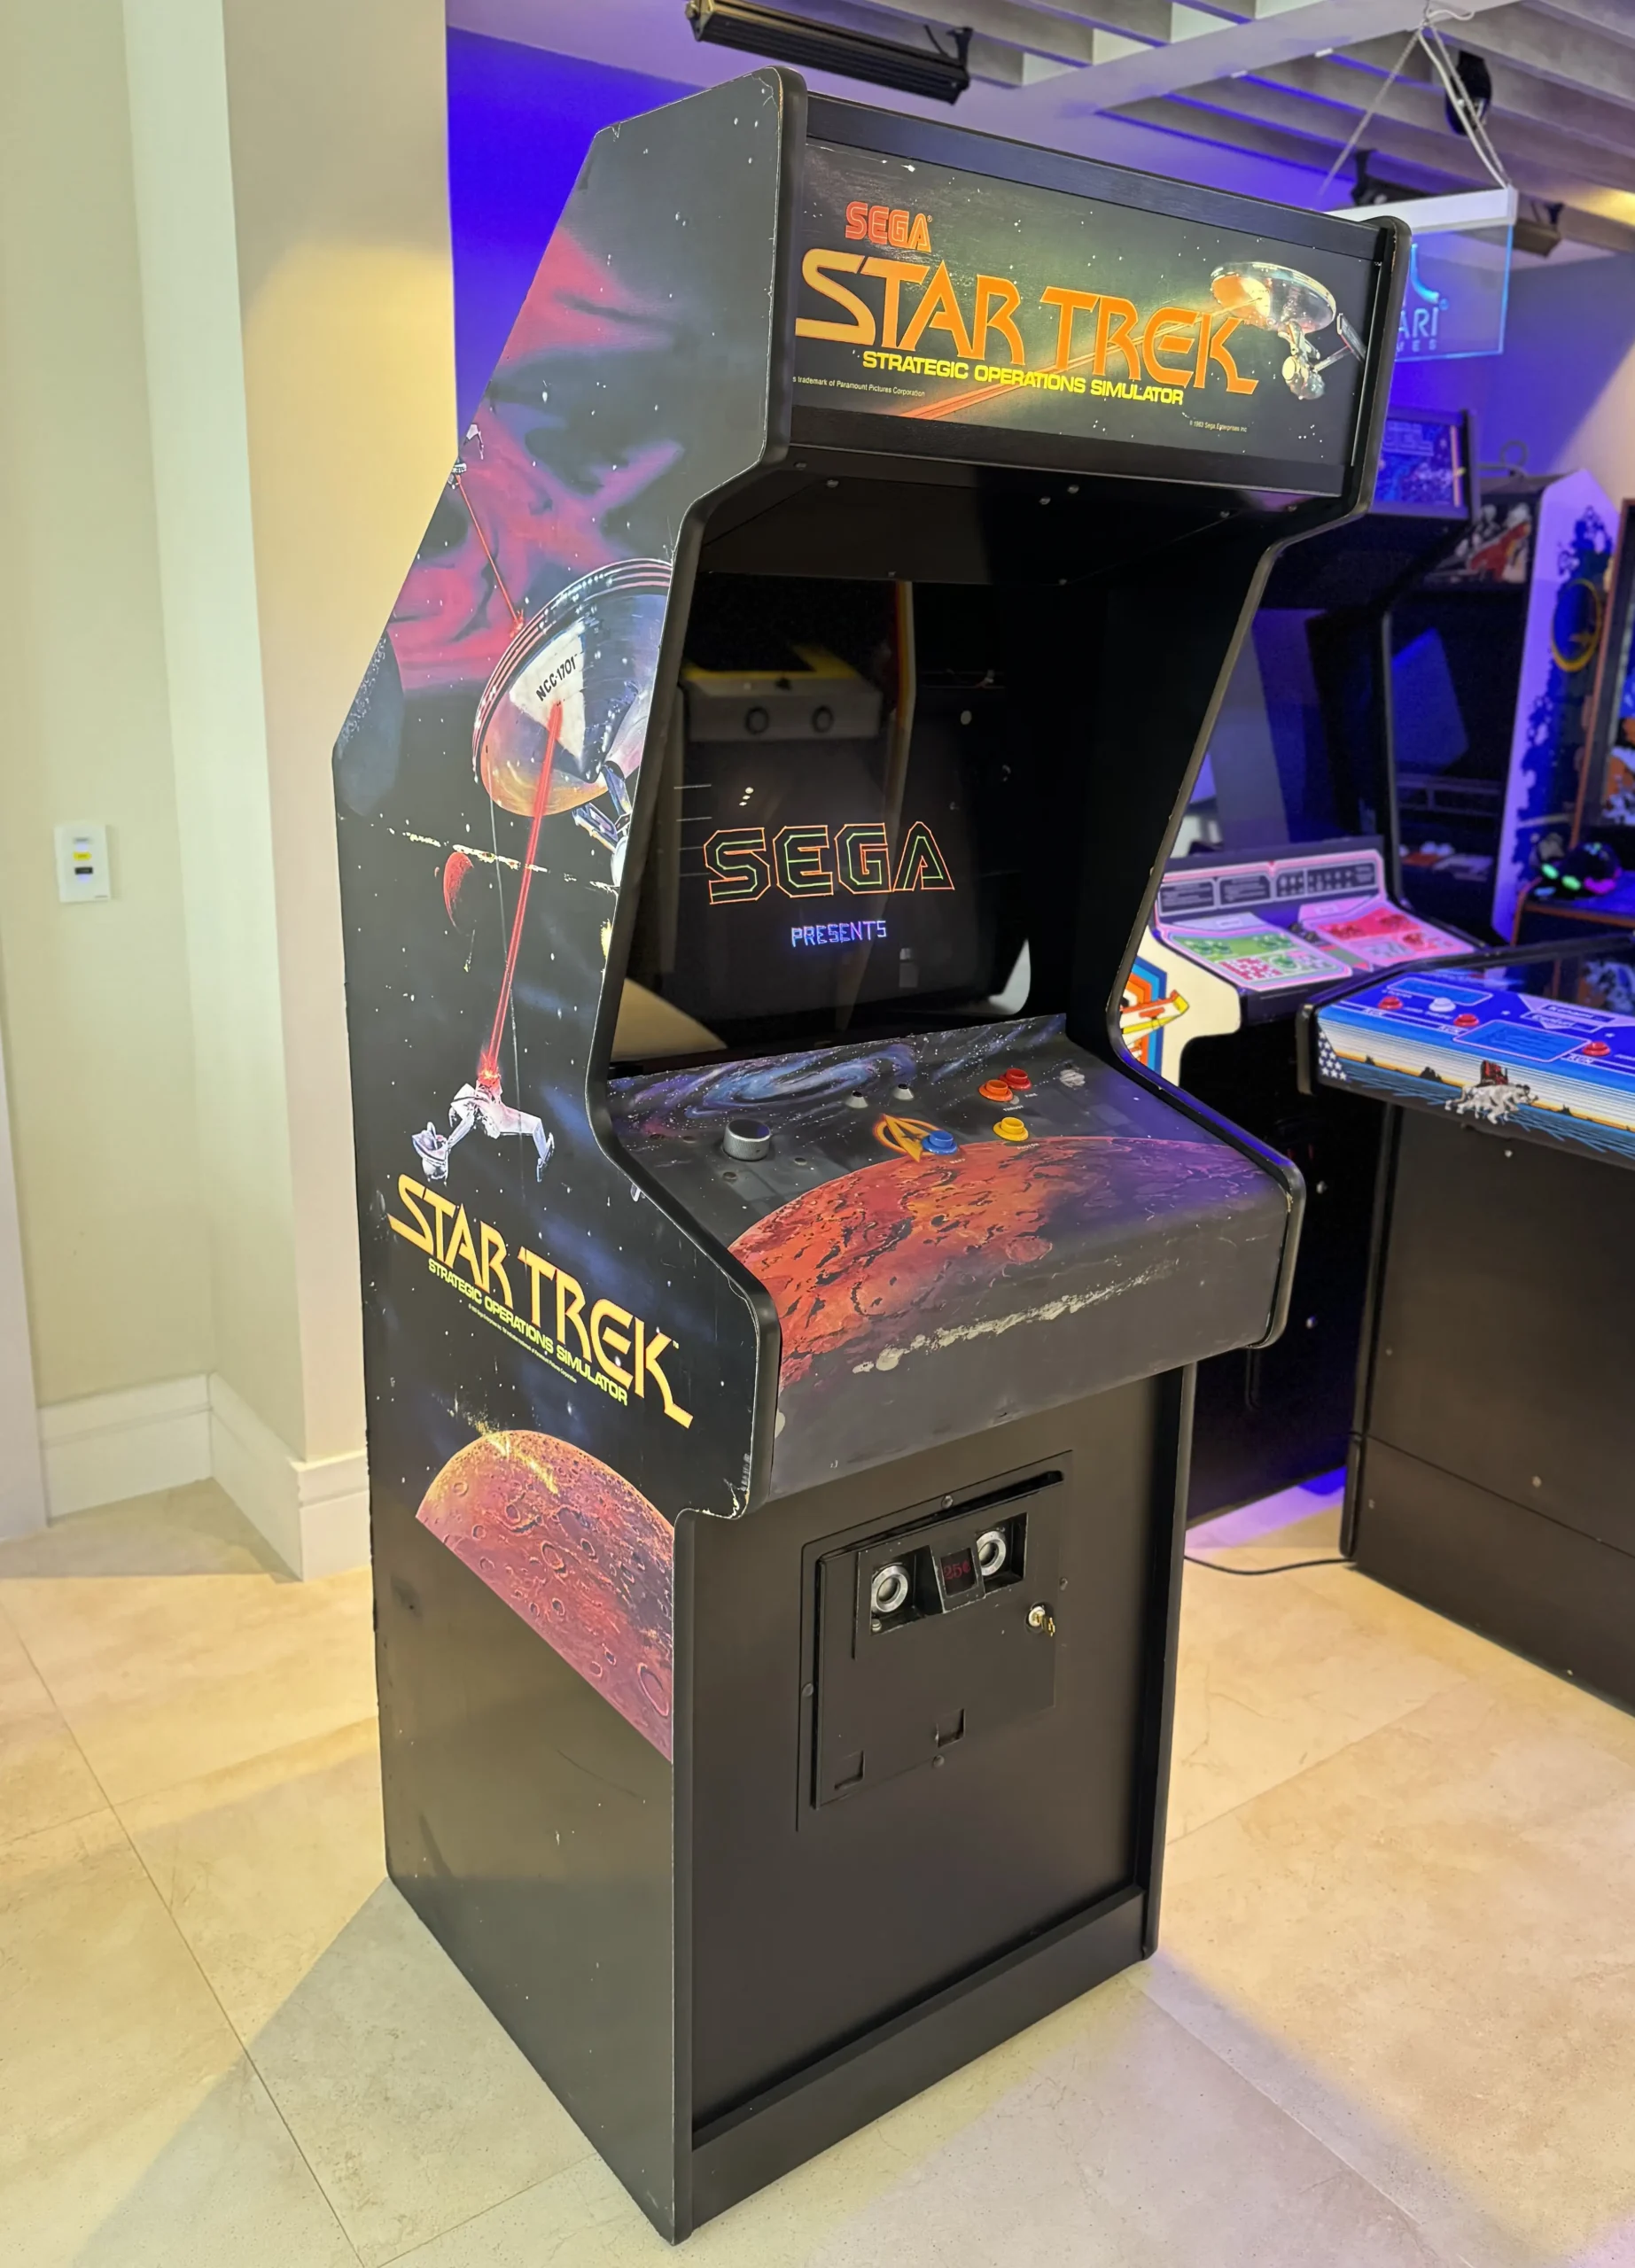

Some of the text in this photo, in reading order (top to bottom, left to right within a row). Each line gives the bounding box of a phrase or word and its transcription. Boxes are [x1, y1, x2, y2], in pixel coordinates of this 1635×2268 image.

[845, 200, 931, 253] SEGA
[795, 248, 1259, 395] STAR TREK
[837, 380, 868, 391] Paramount
[868, 384, 891, 393] Pictures
[892, 387, 925, 397] Corporation
[862, 351, 1183, 406] STRATEGIC OPERATIONS SIMULATOR
[535, 656, 576, 702] NCC-1701
[704, 821, 955, 905] SEGA
[791, 920, 887, 948] PRESENTS
[386, 1174, 513, 1309] STAR
[517, 1246, 694, 1429] TREK
[428, 1257, 628, 1406] STRATEGIC OPERATIONS SIMULATOR
[944, 1559, 971, 1581] 25¢
